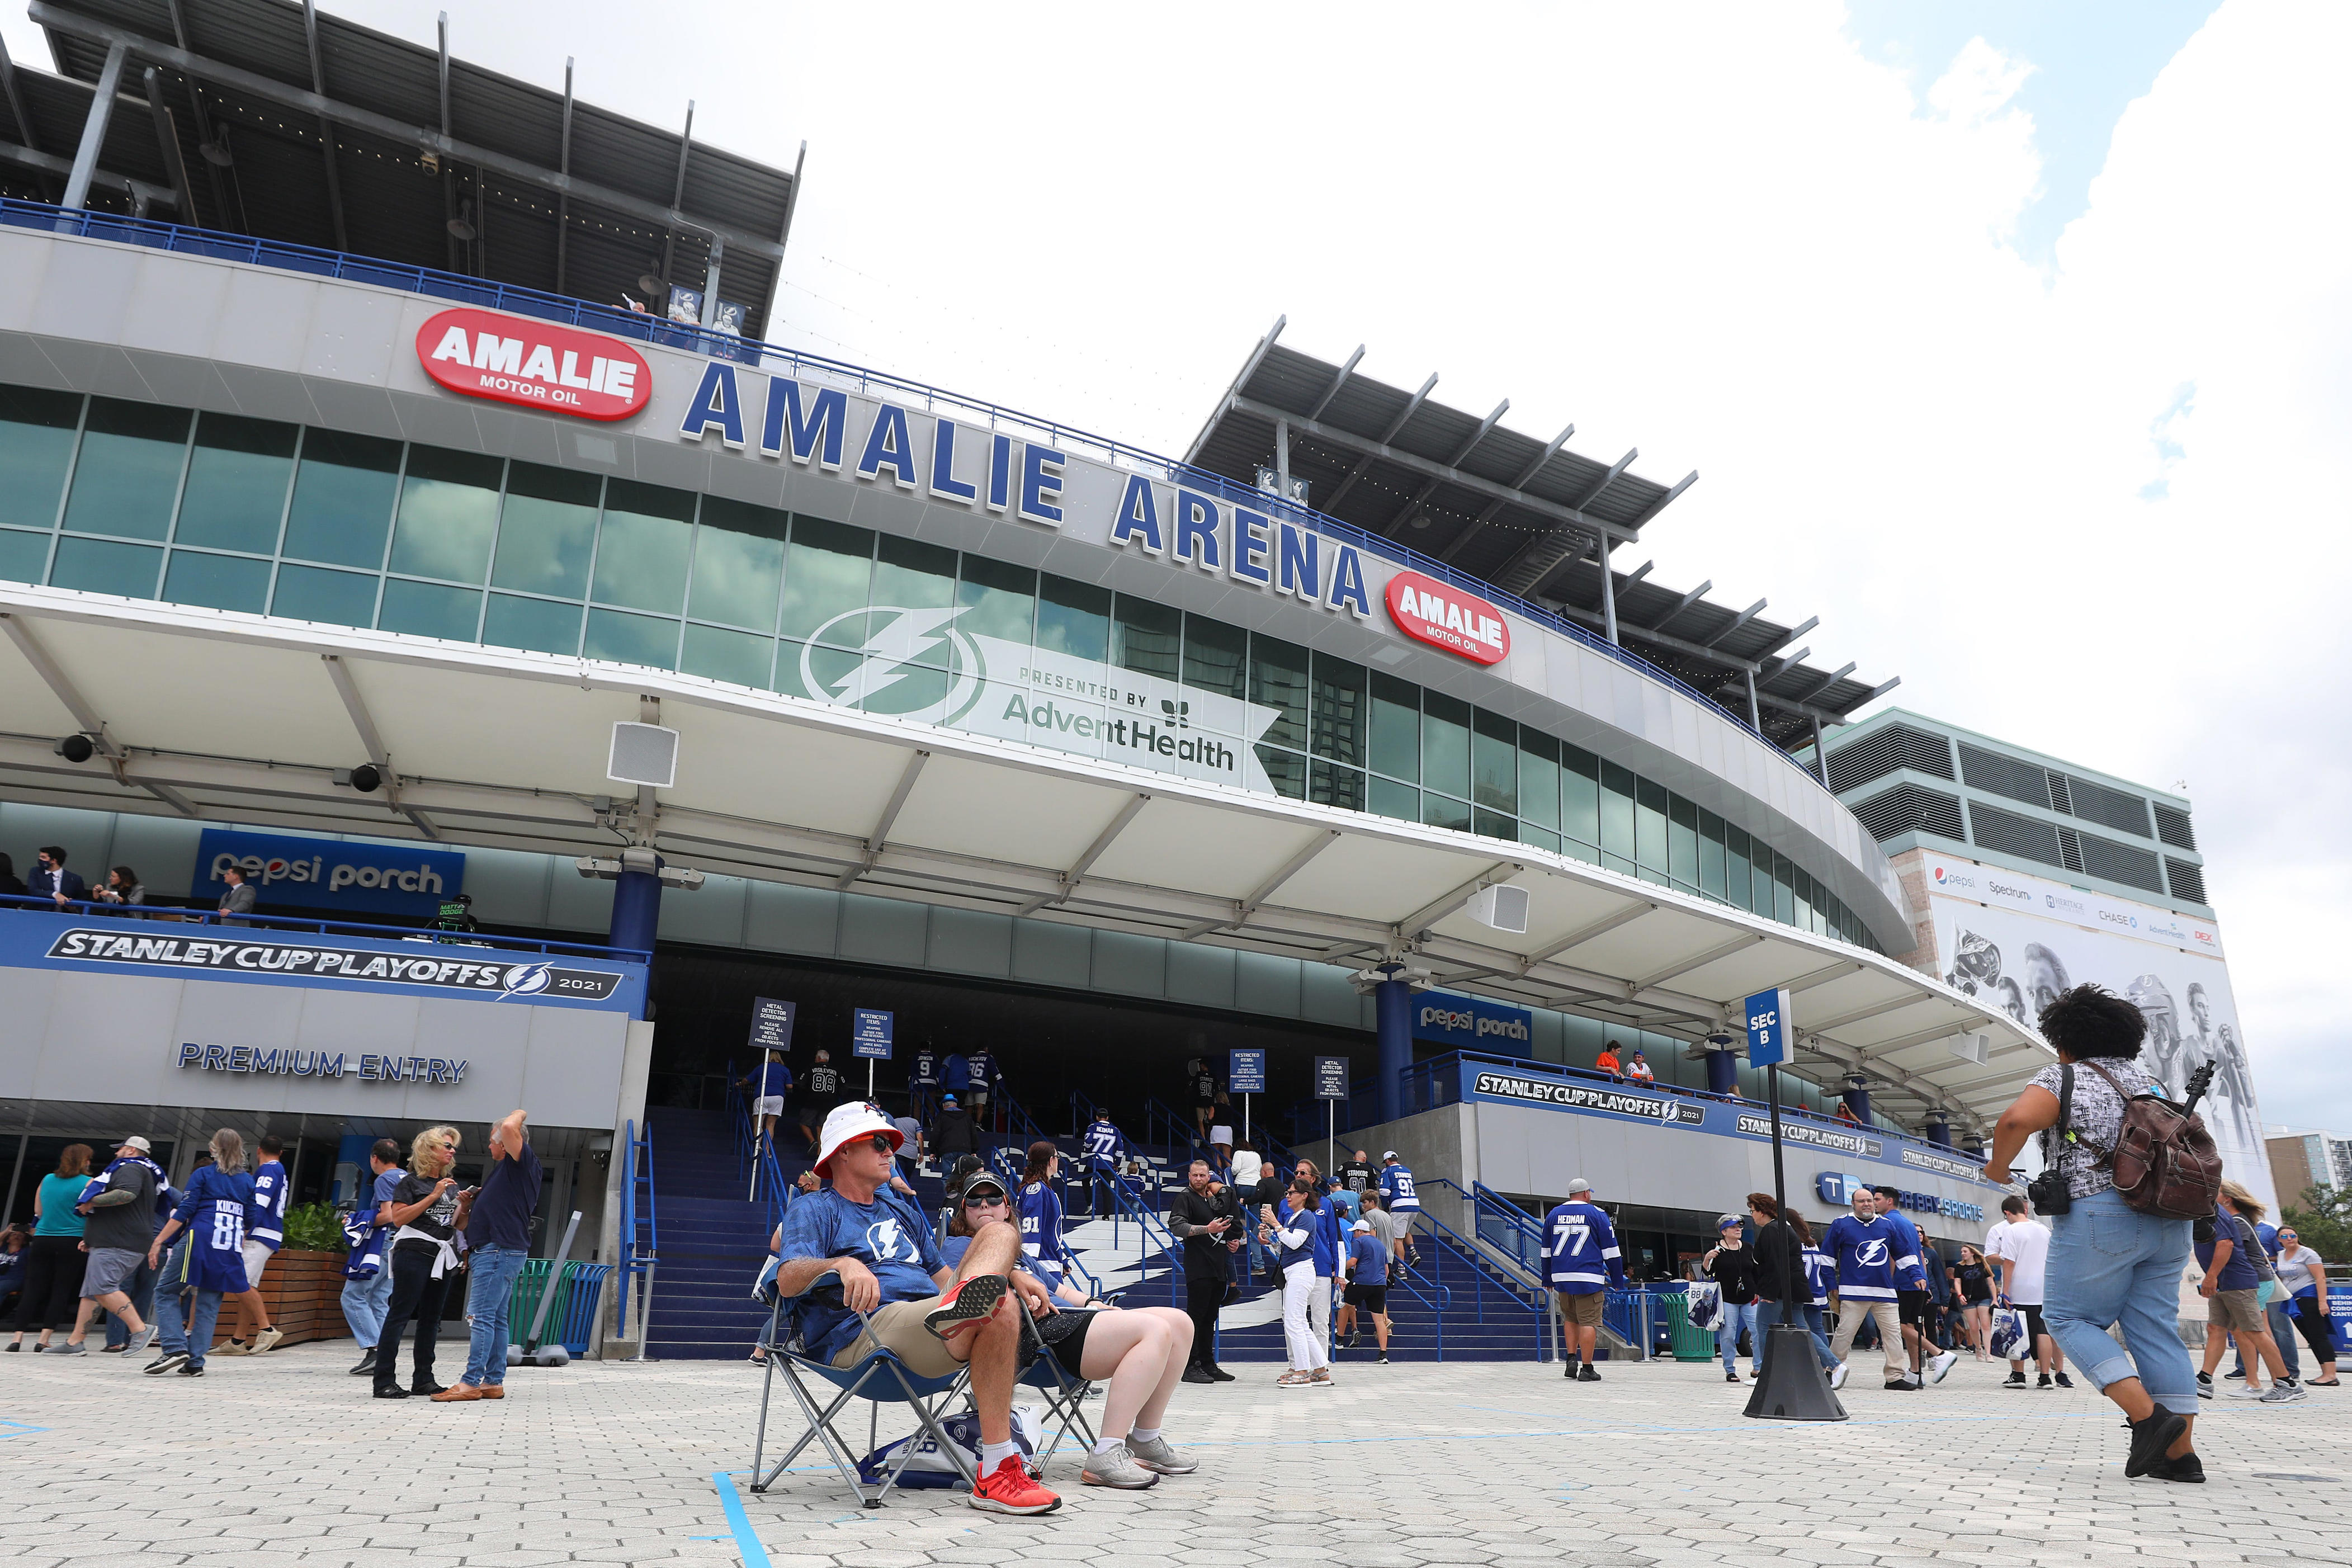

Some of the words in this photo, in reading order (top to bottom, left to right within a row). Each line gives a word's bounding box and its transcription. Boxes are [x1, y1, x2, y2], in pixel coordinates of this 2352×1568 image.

[431, 326, 637, 398] AMALIE
[479, 374, 546, 399] MOTOR
[551, 389, 581, 405] OIL
[679, 360, 1066, 527] AMALIE
[1109, 474, 1372, 620] ARENA
[1400, 585, 1503, 649] AMALIE
[1427, 625, 1461, 646] MOTOR
[1463, 639, 1479, 653] OIL
[1019, 667, 1118, 701] PRESENTED
[1127, 692, 1147, 708] BY
[1002, 693, 1234, 771] AdventHealth
[210, 852, 322, 886] pepsi
[329, 864, 443, 894] porch
[1949, 874, 1976, 888] pepsi
[1989, 881, 2029, 900] Spectrum
[2099, 910, 2129, 925] CHASE
[2195, 931, 2213, 943] DEX
[60, 932, 238, 965] STANLEY
[235, 946, 314, 971] CUP
[313, 952, 500, 986] PLAYOFFS
[559, 979, 602, 991] 2021
[760, 1013, 787, 1021] SCREENING
[762, 1008, 787, 1016] DETECTOR
[1750, 1010, 1776, 1031] SEC
[1420, 1007, 1473, 1031] pepsi
[1476, 1017, 1528, 1041] porch
[1760, 1030, 1769, 1045] B
[176, 1041, 345, 1079] PREMIUM
[356, 1052, 468, 1084] ENTRY
[920, 1061, 930, 1076] 9
[812, 1073, 835, 1093] 88
[1199, 1081, 1212, 1097] 91
[1479, 1075, 1555, 1100] STANLEY
[1553, 1087, 1587, 1104] CUP
[1587, 1092, 1660, 1117] PLAYOFFS
[1682, 1110, 1700, 1119] 2021
[1096, 1126, 1113, 1134] HEDMAN
[1740, 1117, 1788, 1137] STANLY
[1788, 1126, 1808, 1141] CUP
[1809, 1128, 1855, 1150] PLAYOFFS
[1092, 1132, 1116, 1153] 77
[1903, 1150, 1933, 1168] STANLEY
[1932, 1158, 1945, 1170] CUP
[1945, 1161, 1973, 1178] PLAYOFFS
[256, 1175, 273, 1189] 86
[1349, 1177, 1367, 1196] 91
[1398, 1178, 1416, 1197] 91
[1912, 1192, 1940, 1213] BAY
[1940, 1198, 1984, 1222] SPORTS
[1022, 1216, 1040, 1234] 91
[1557, 1215, 1585, 1224] HEDMAN
[1553, 1224, 1590, 1256] 77
[1691, 1290, 1701, 1298] 88
